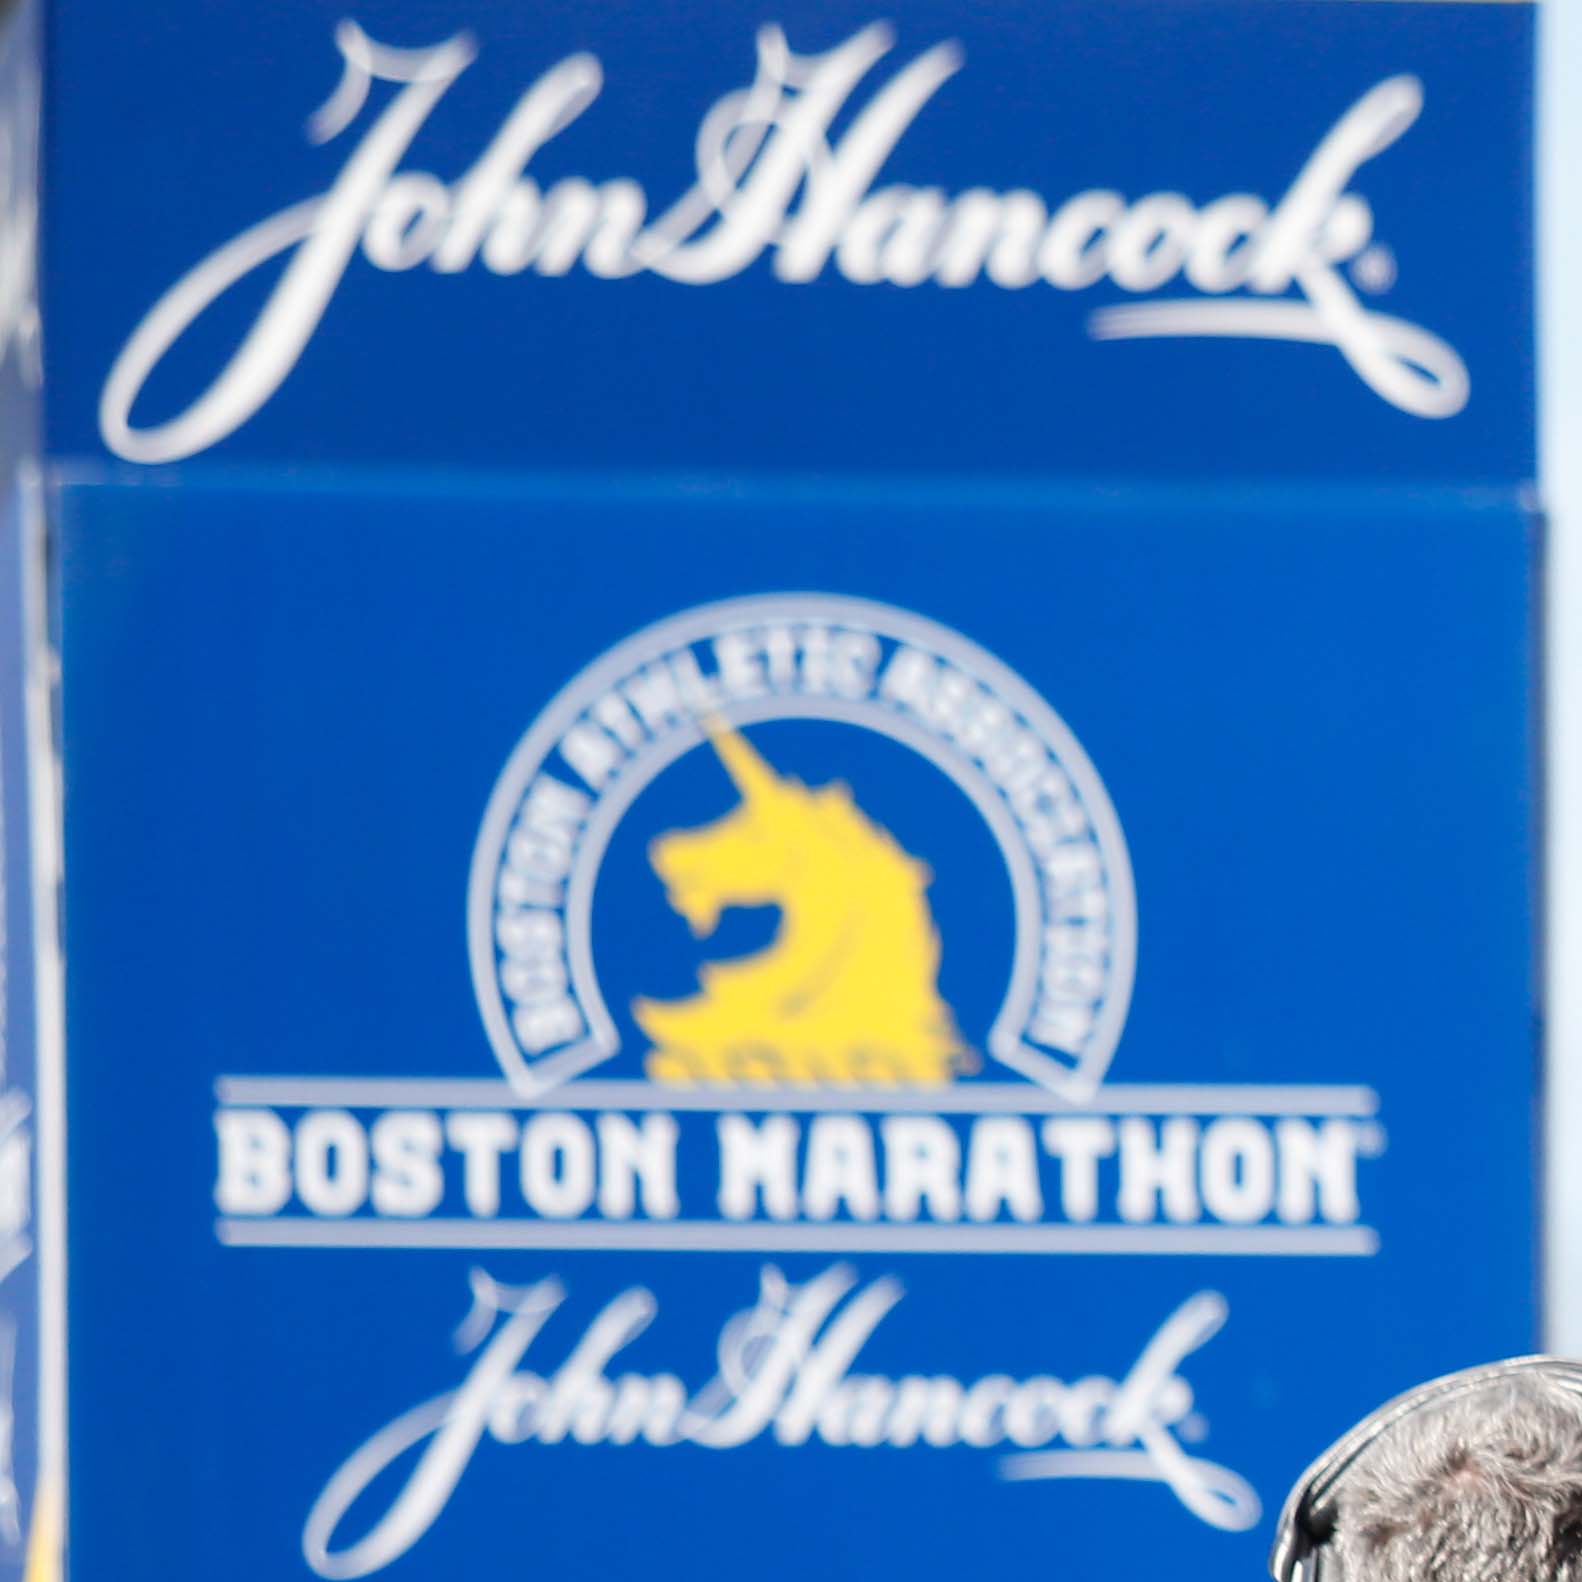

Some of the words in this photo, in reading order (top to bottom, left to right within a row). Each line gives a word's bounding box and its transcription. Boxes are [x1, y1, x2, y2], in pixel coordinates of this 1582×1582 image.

[100, 15, 648, 465] John
[635, 19, 1469, 419] Hancock
[216, 1108, 680, 1221] BOSTON
[716, 1114, 1359, 1225] MARATHON
[302, 1263, 683, 1580] John
[680, 1263, 1262, 1532] Hancock
